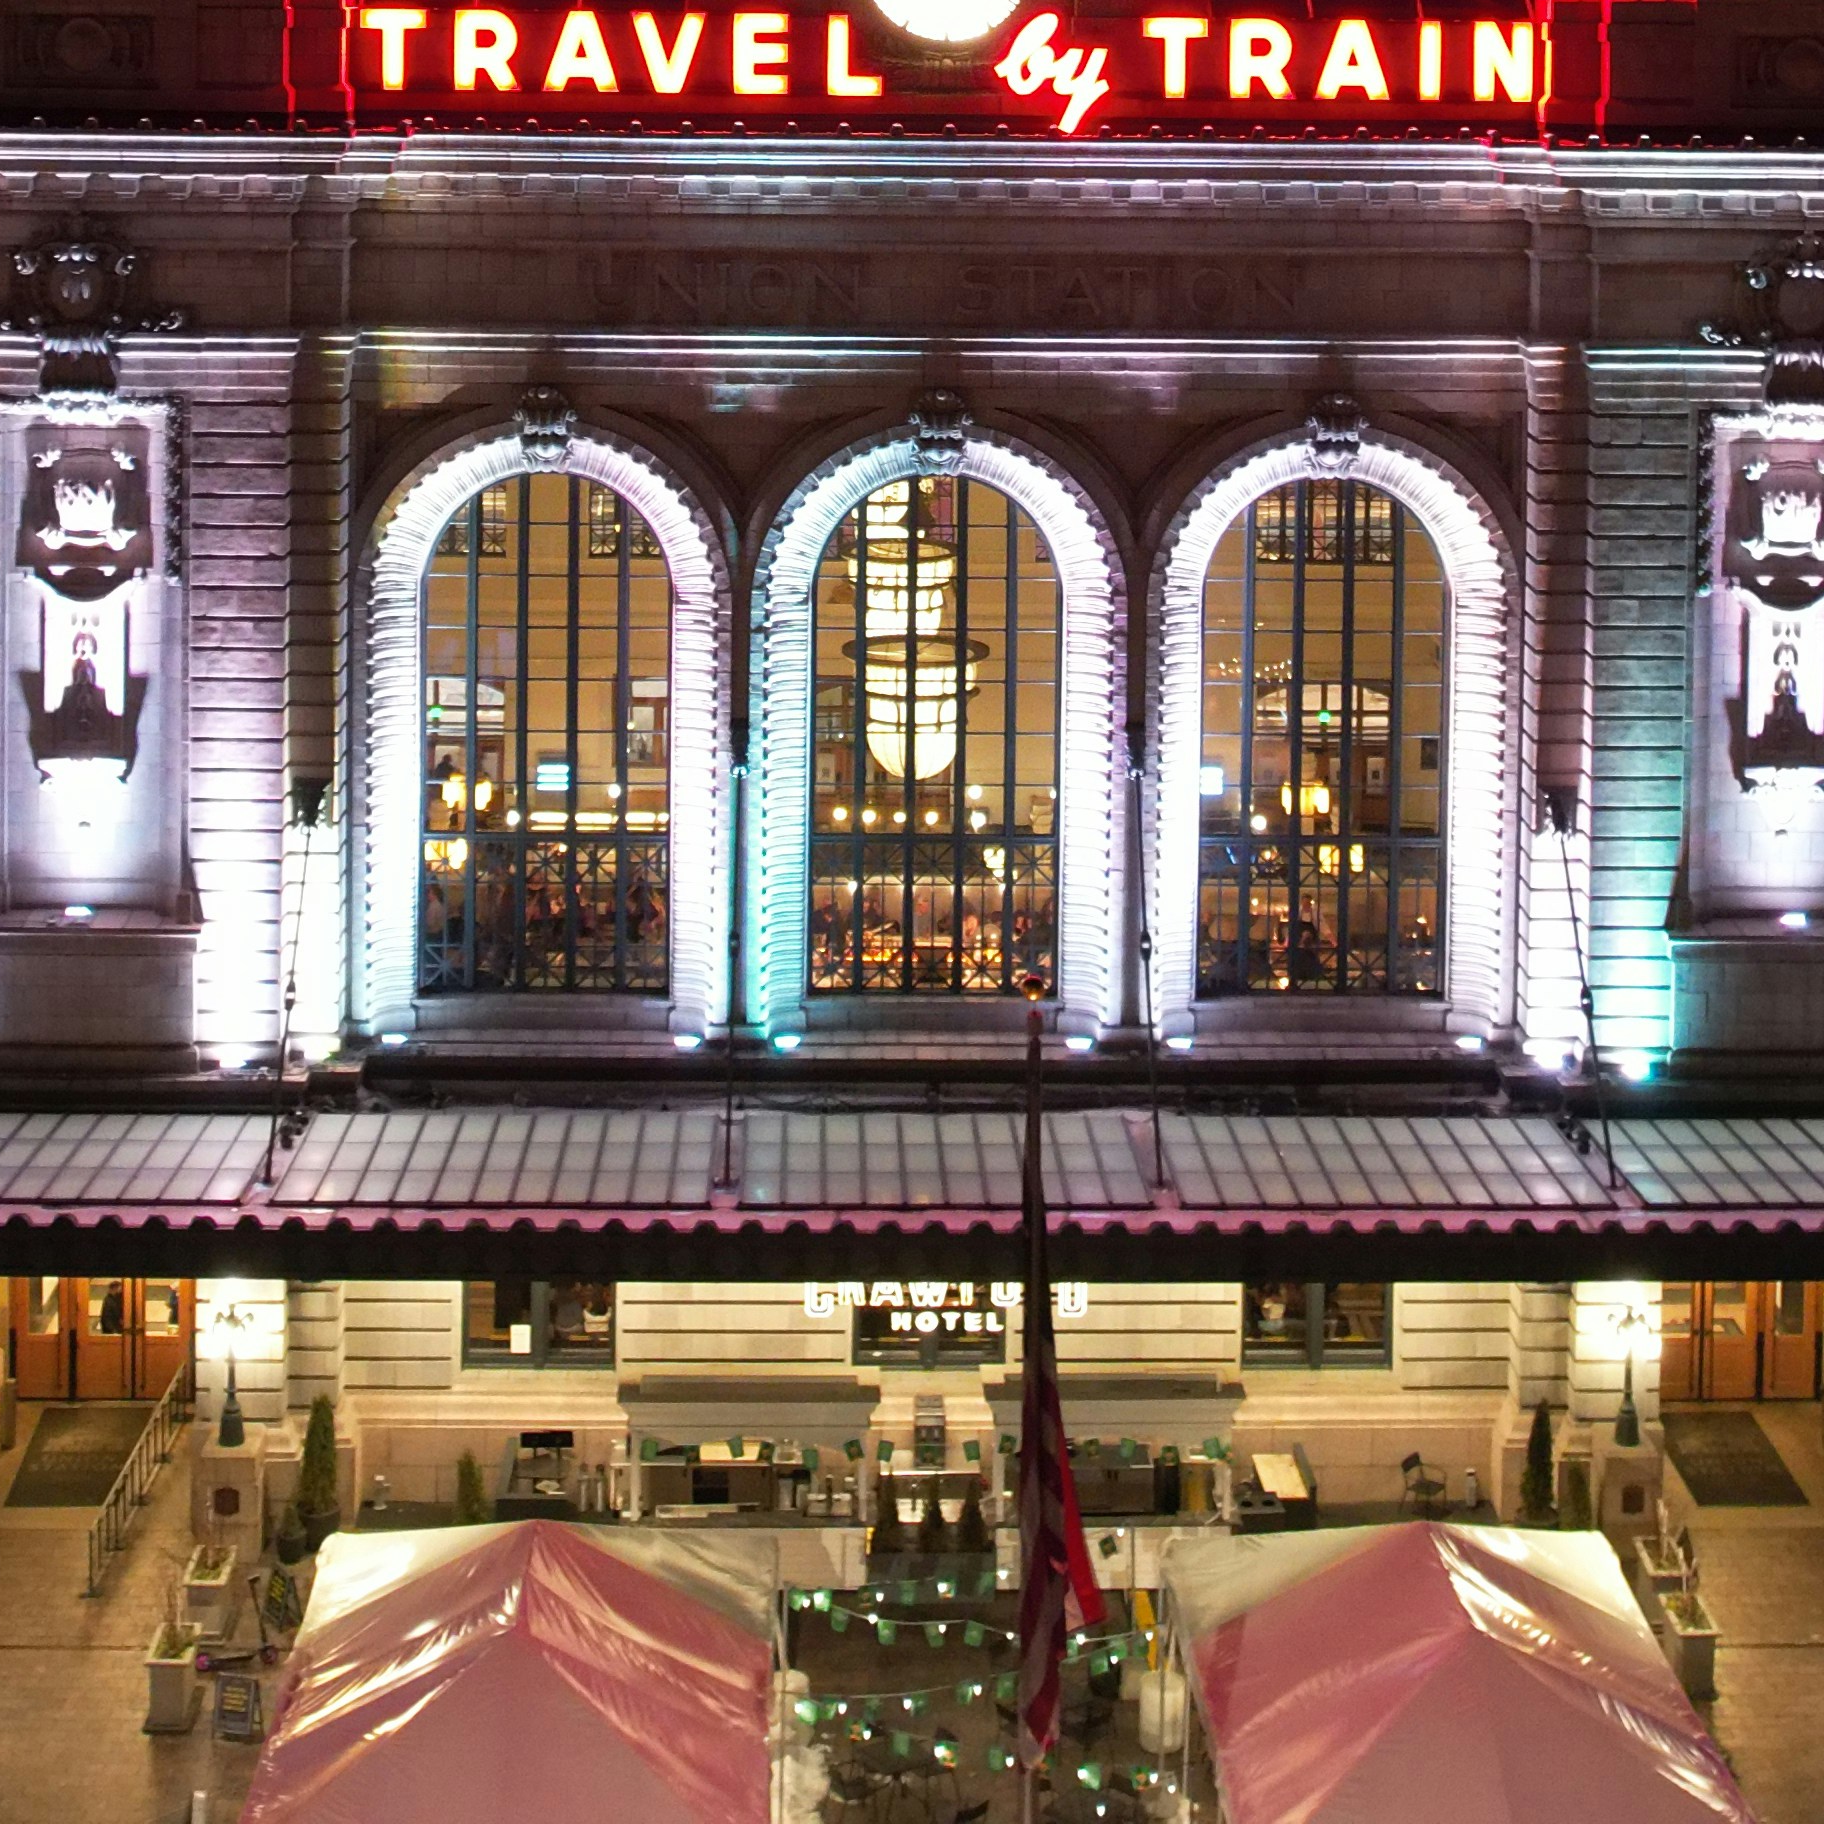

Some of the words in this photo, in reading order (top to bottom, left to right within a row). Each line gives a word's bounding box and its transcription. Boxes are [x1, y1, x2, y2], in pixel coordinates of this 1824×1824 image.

[359, 8, 884, 98] TRAVEL
[992, 12, 1111, 135] by
[1142, 16, 1535, 104] TRAIN
[584, 262, 862, 318] UNION
[953, 264, 1304, 318] STATION
[803, 1281, 1089, 1319] CAWOD
[890, 1311, 1005, 1332] HOTEL
